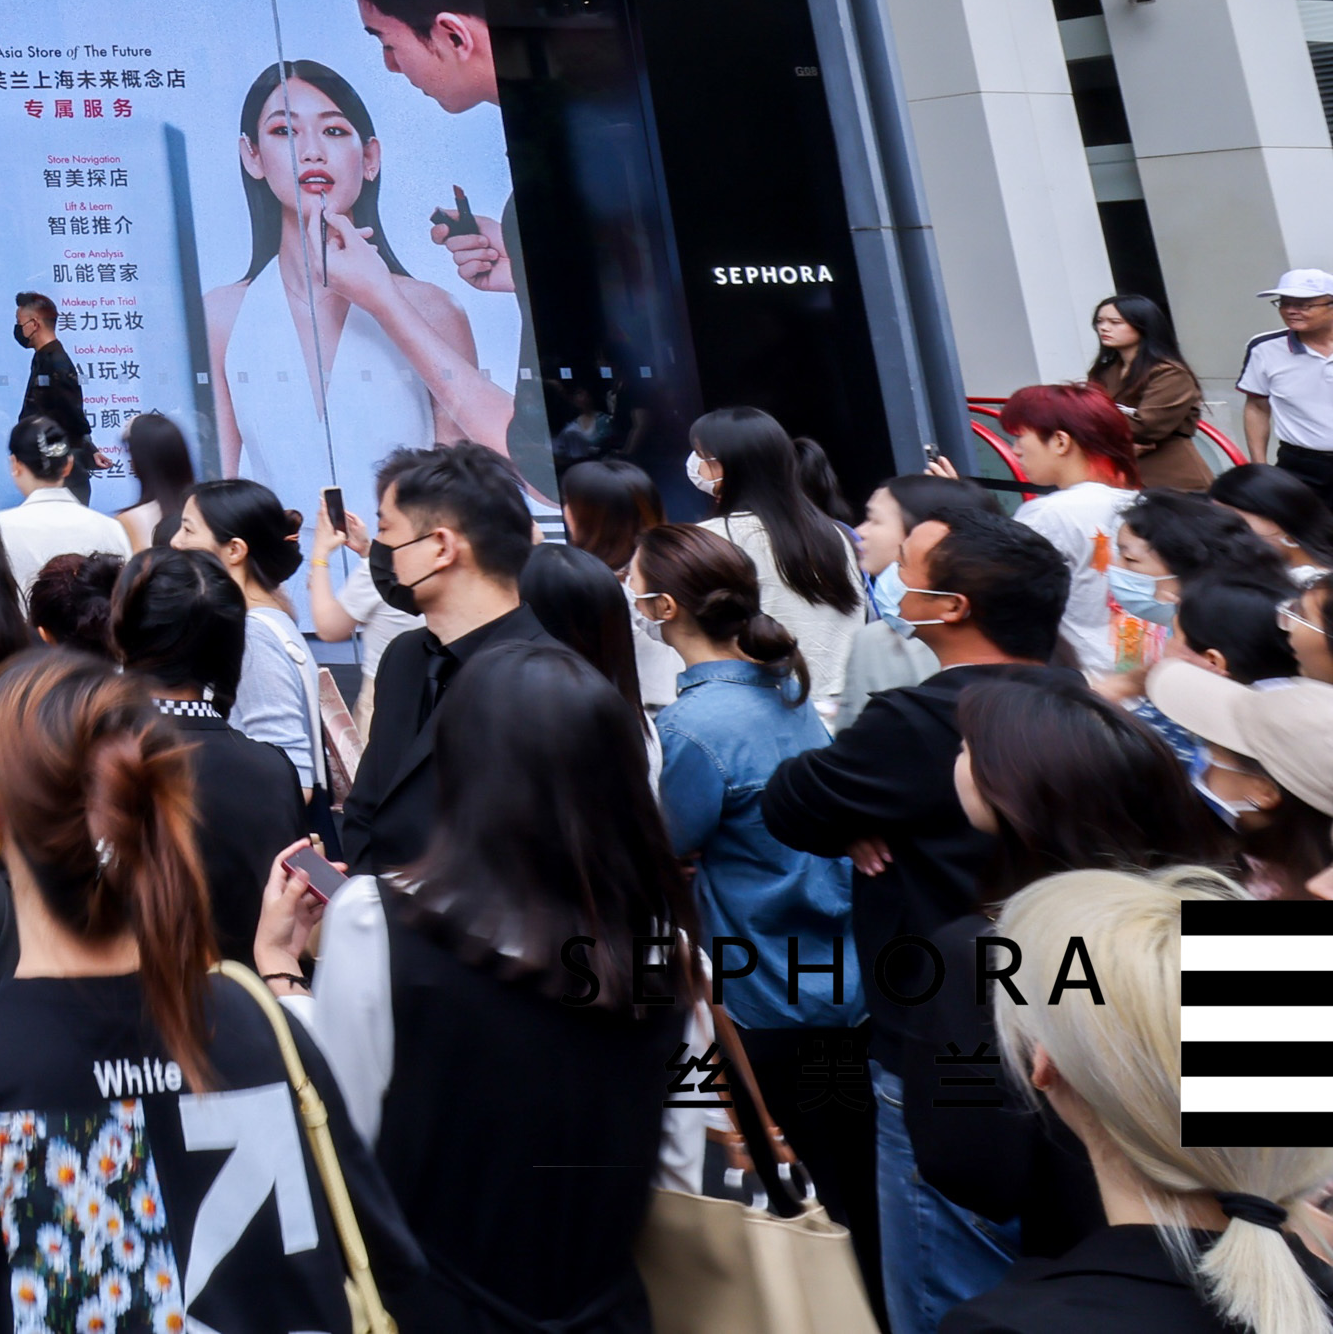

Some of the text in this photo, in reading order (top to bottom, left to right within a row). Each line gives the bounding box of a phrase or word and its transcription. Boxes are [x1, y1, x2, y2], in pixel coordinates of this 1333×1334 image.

[27, 46, 62, 58] Store
[66, 44, 80, 61] of
[84, 45, 107, 57] The
[112, 45, 152, 57] Future
[24, 98, 133, 119] 专属服务
[47, 155, 121, 166] Store Navigation
[43, 168, 128, 188] 智美探店
[65, 201, 113, 211] Lift & Learn
[48, 215, 133, 235] 智能推介
[64, 249, 124, 260] Care Analysis
[53, 263, 139, 283] 肌能管家
[712, 264, 834, 286] SEPHORA
[62, 296, 137, 309] Makeup Fun Trial
[58, 311, 145, 331] 美力玩妆
[74, 345, 134, 356] Look Analysis
[82, 394, 140, 405] eauty Events
[94, 1057, 183, 1099] White
